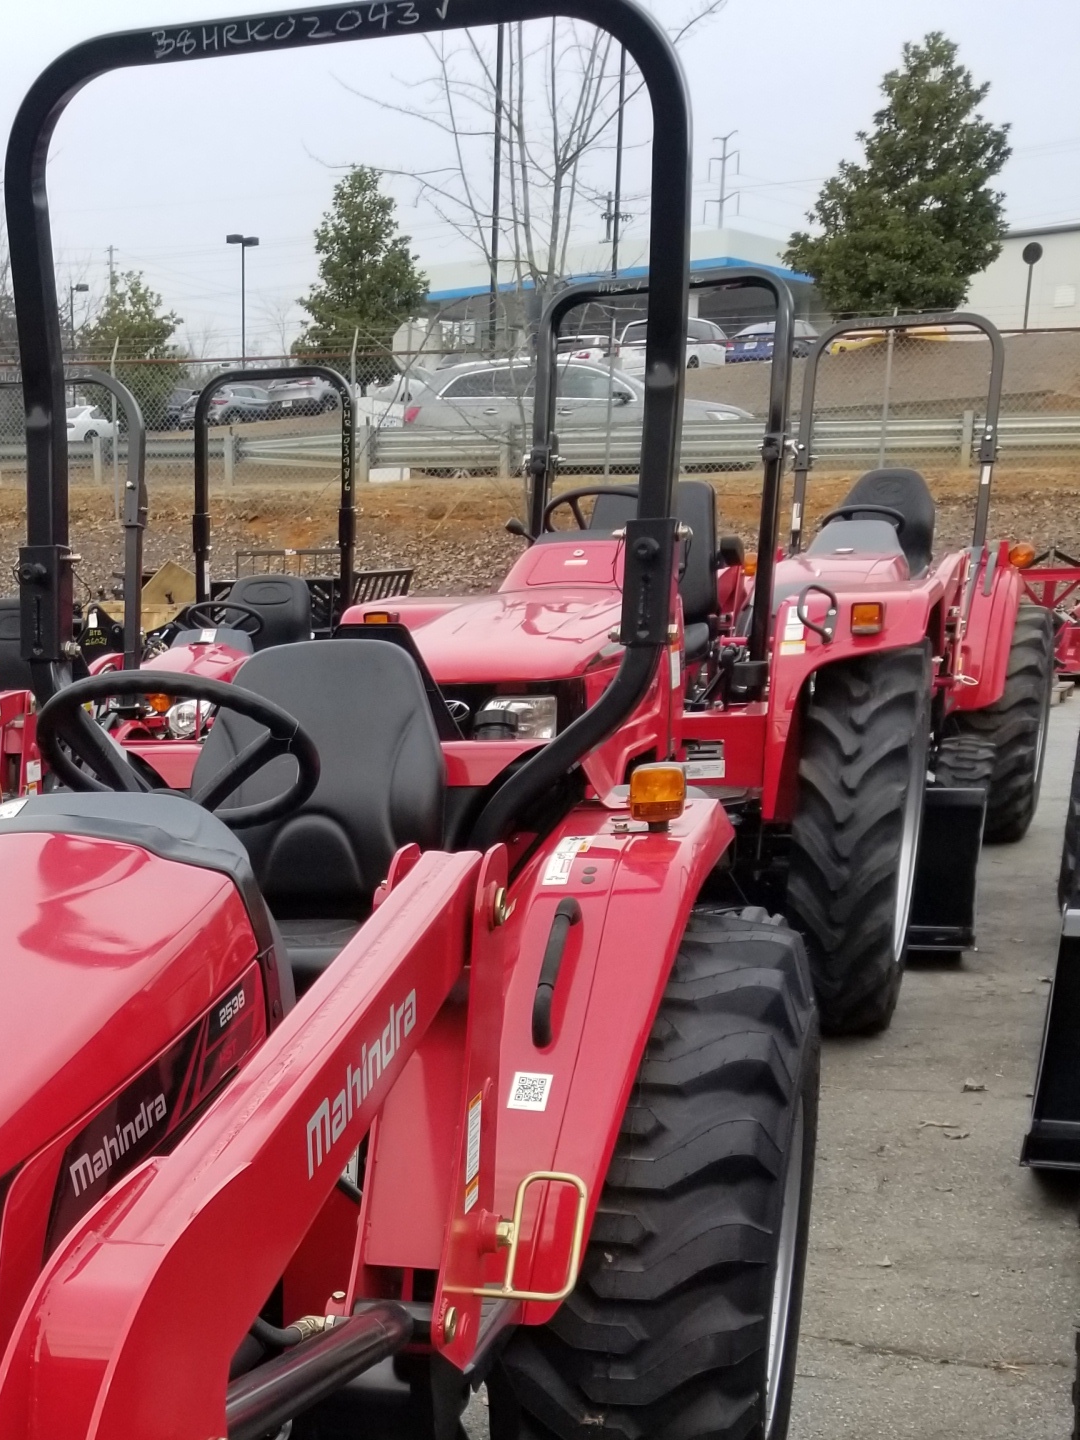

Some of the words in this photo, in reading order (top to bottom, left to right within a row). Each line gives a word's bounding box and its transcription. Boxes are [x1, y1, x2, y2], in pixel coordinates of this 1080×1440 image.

[219, 989, 245, 1028] 2538
[306, 988, 418, 1181] Mahindra
[69, 1093, 167, 1197] Mahindra
